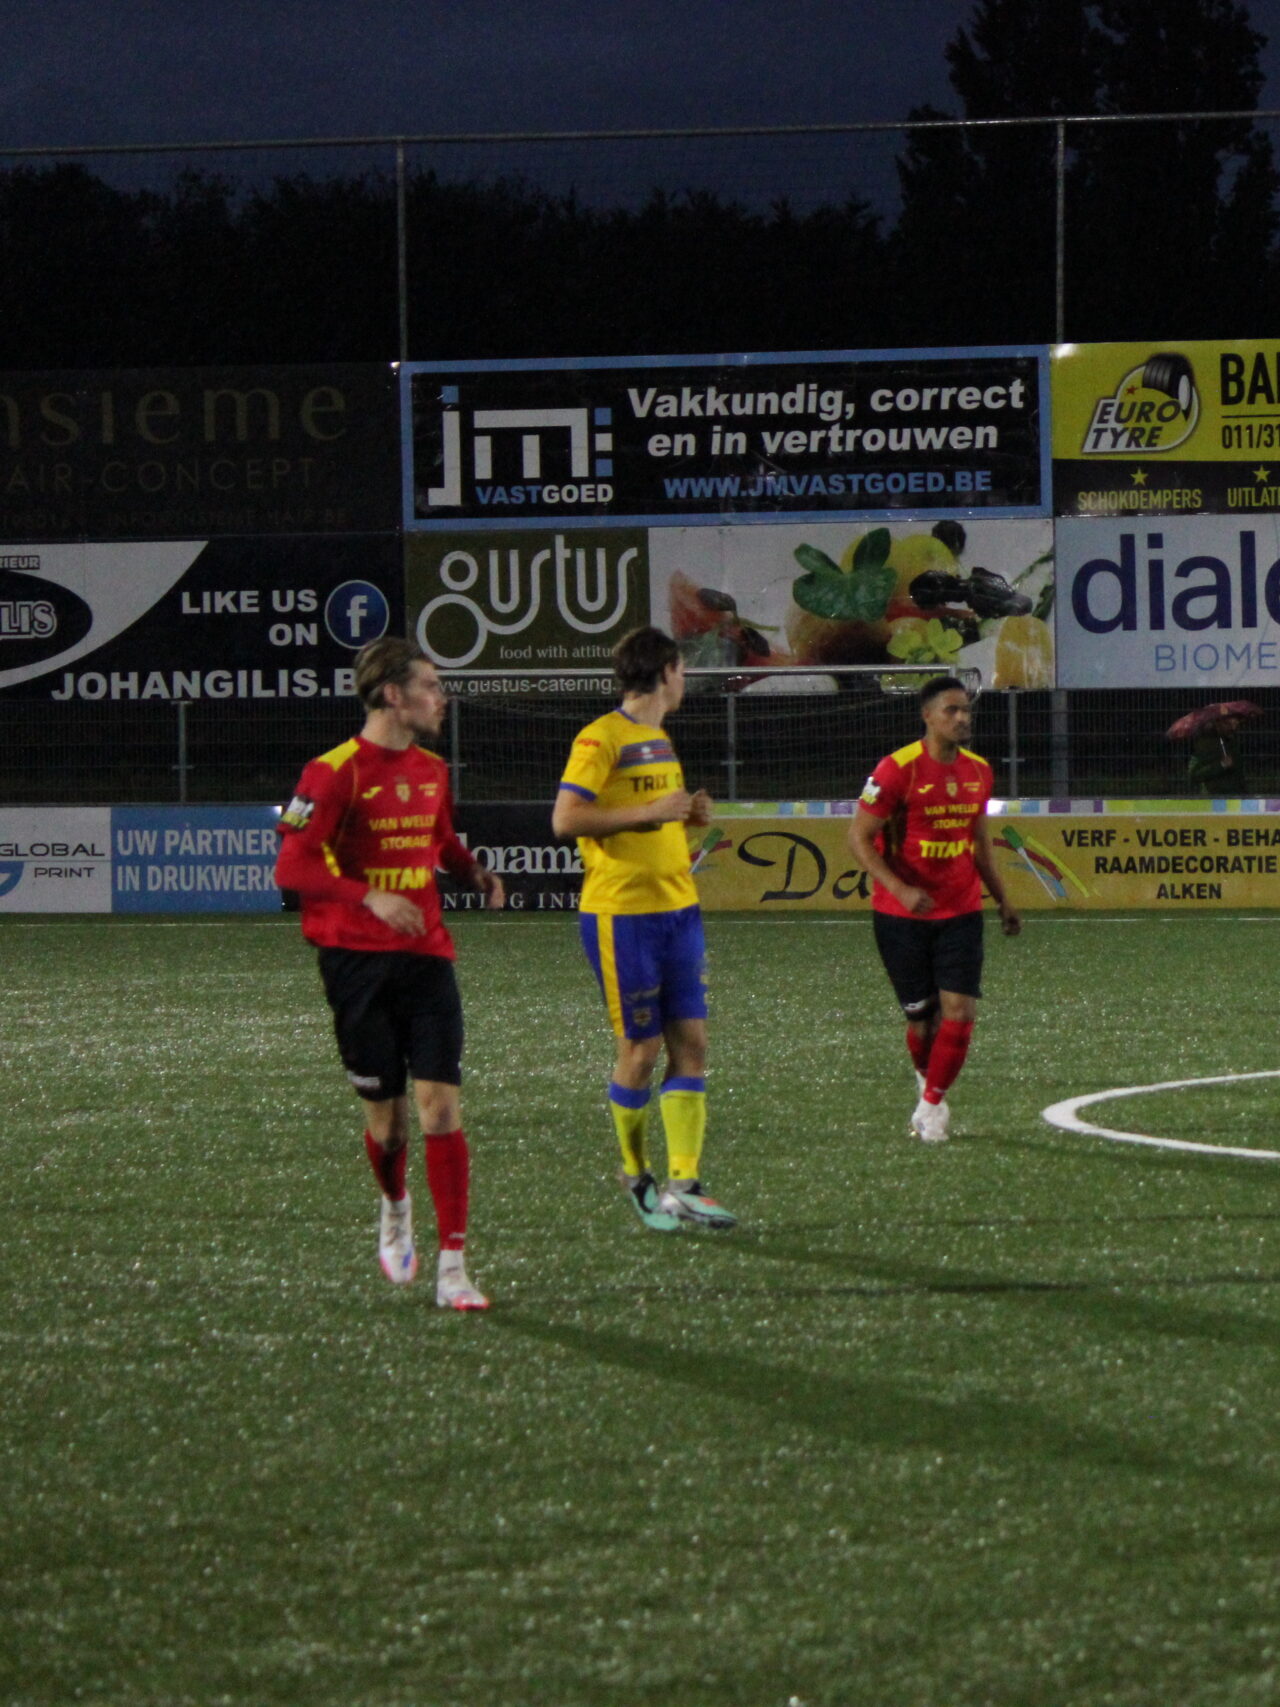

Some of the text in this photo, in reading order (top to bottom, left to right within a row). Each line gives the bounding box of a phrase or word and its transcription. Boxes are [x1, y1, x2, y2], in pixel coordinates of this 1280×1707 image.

[628, 379, 1025, 421] Vakkundig, correct
[1096, 401, 1182, 424] EURO
[647, 423, 998, 457] en in vertrouwen
[1091, 426, 1164, 449] TYRE
[476, 483, 613, 505] VASTGOED
[664, 471, 992, 498] WWW.JMVASTGOED.BE
[1078, 489, 1202, 511] SCHOKDEMPERS
[0, 558, 39, 569] IEUR
[182, 589, 318, 615] LIKE US
[417, 534, 638, 668] gustus
[269, 623, 318, 646] ON
[500, 644, 617, 659] food with attitu
[369, 817, 398, 832] VAN
[117, 828, 277, 857] UW PARTNER
[1061, 829, 1117, 848] VERF
[1136, 829, 1207, 847] VLOER
[0, 843, 105, 857] GLOBAL
[34, 867, 95, 878] PRINT
[1094, 855, 1278, 874] RAAMDECORATIE
[117, 865, 277, 892] IN DRUKWERK
[1156, 883, 1222, 900] ALKEN
